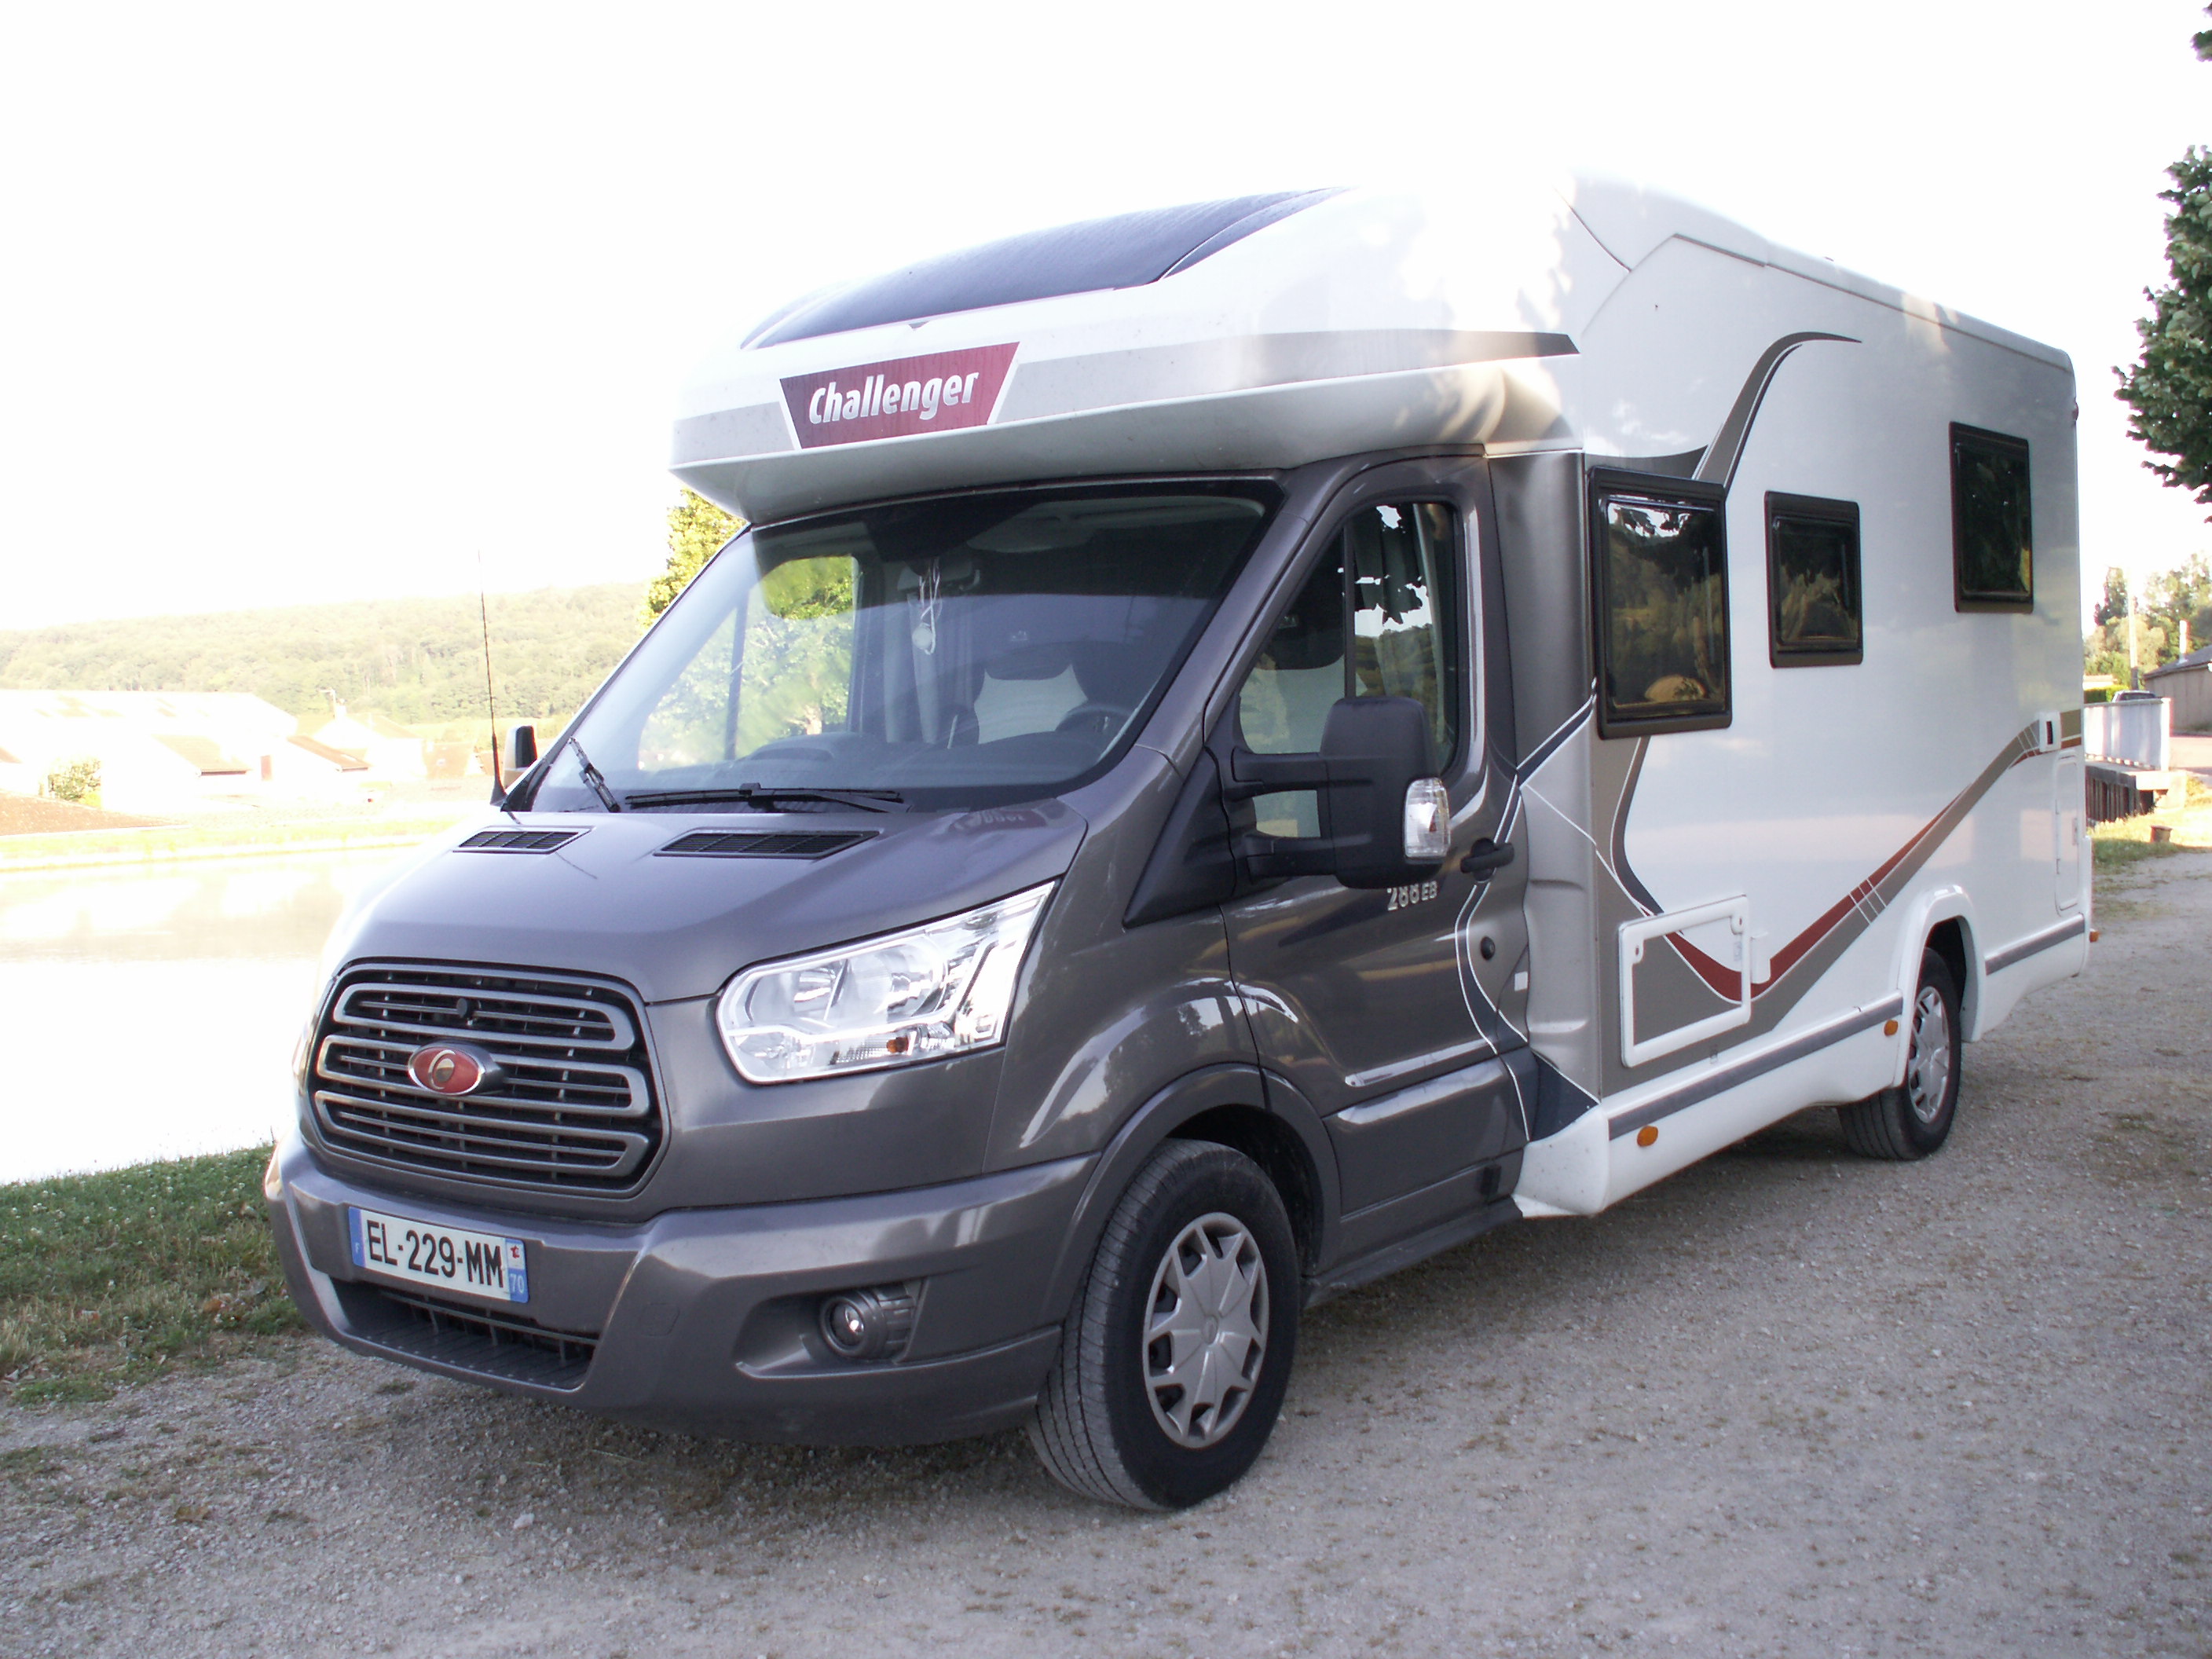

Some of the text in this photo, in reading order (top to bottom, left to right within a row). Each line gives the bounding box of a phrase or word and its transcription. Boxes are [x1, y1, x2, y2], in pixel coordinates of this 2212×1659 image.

[809, 372, 980, 424] Challenger
[366, 1219, 504, 1288] EL-229-MM
[511, 1273, 525, 1294] 70
